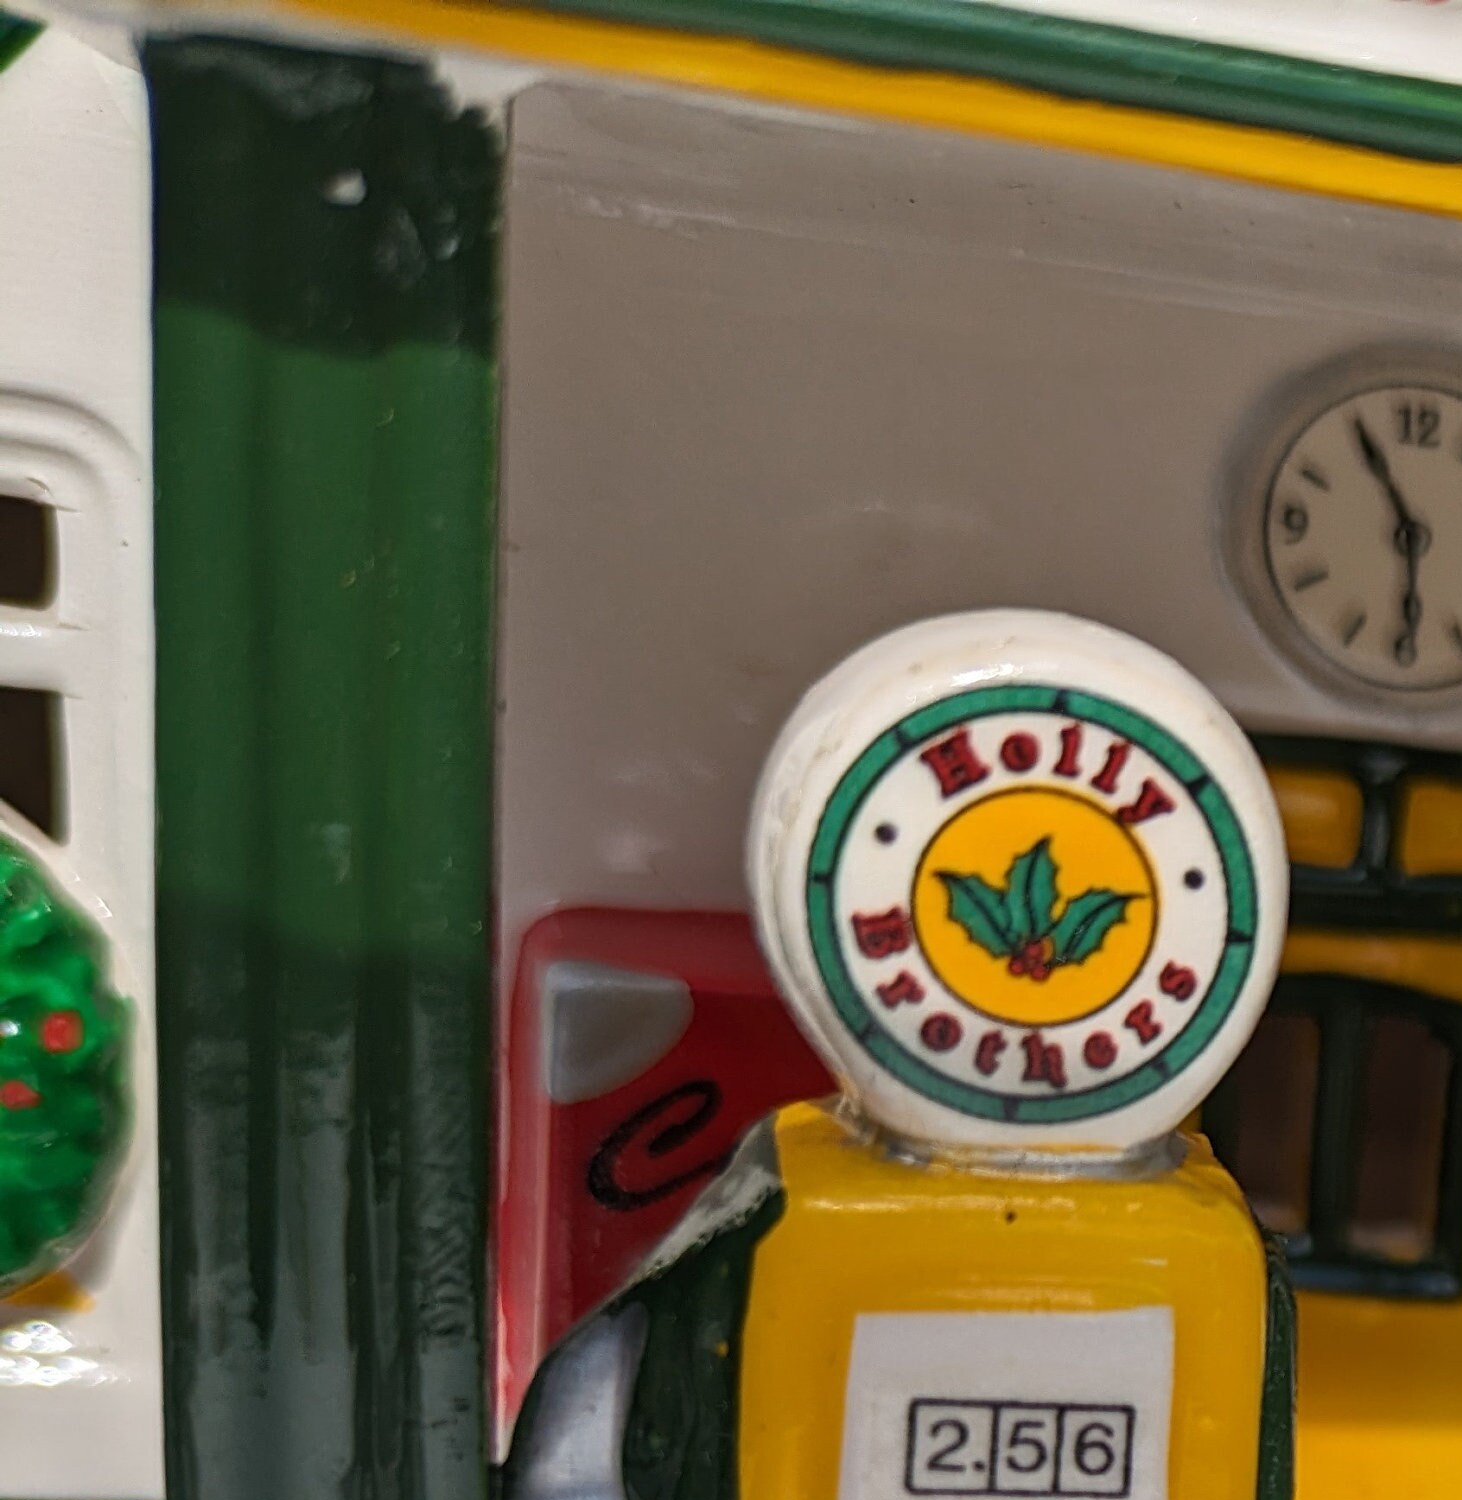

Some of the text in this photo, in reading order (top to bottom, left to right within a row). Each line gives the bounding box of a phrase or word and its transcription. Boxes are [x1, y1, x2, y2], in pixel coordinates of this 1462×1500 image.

[1398, 405, 1442, 447] 12
[920, 721, 1176, 825] Holly
[851, 906, 1197, 1089] Brothers
[926, 1419, 1115, 1476] 2.56
